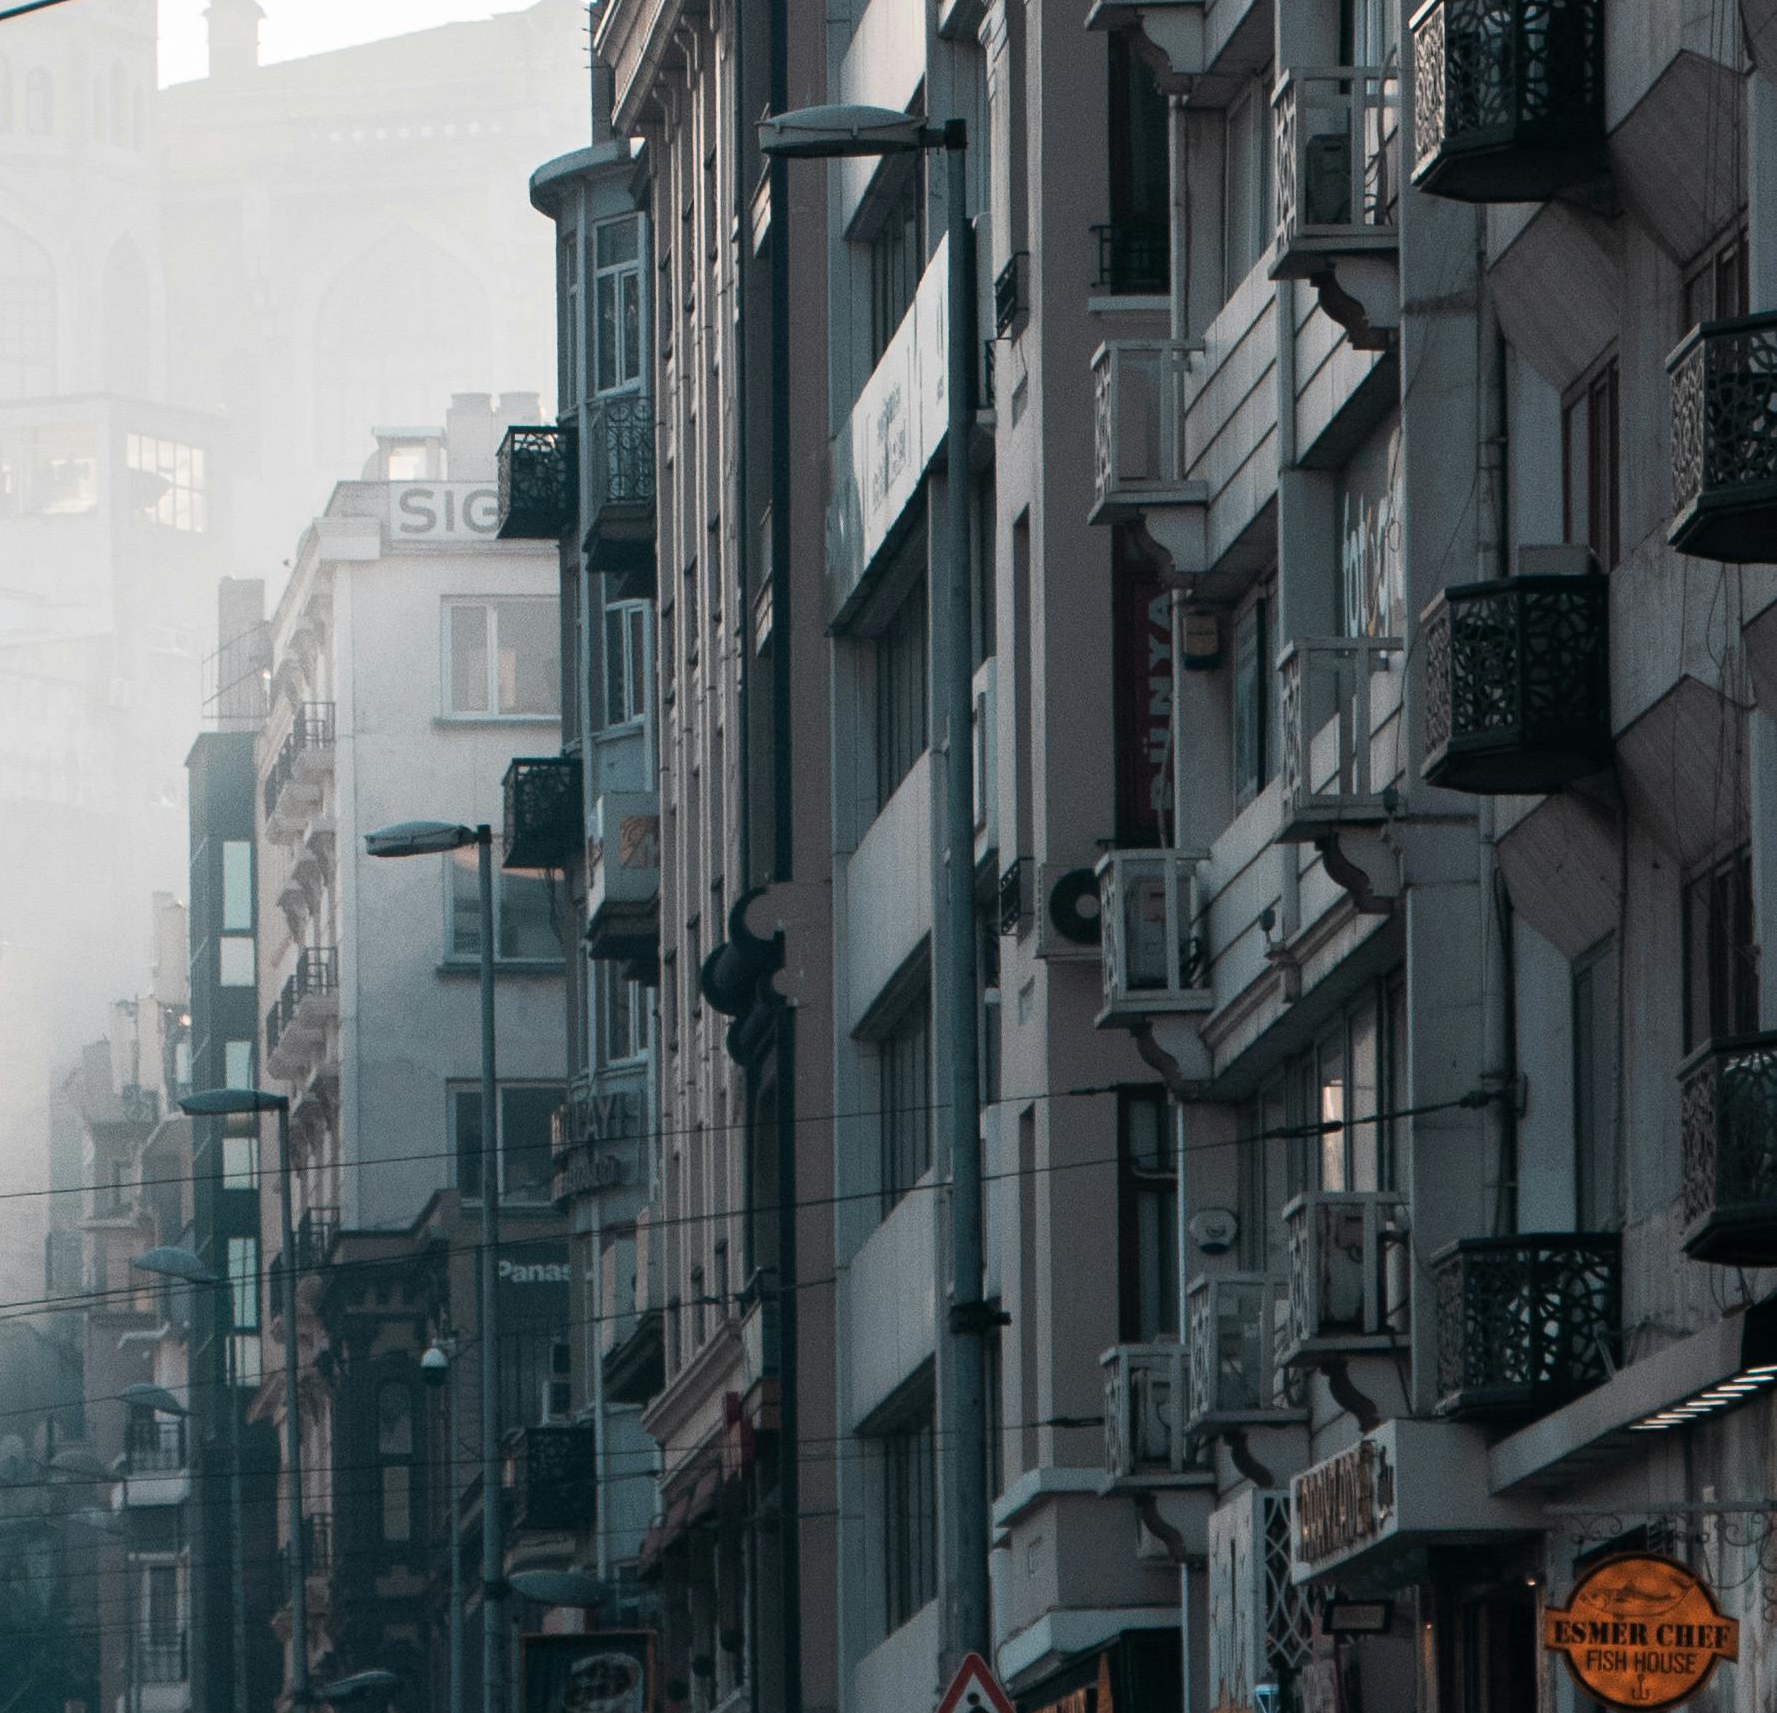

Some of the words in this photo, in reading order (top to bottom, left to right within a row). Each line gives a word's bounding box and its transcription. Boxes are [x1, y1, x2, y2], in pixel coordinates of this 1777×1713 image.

[1554, 1619, 1649, 1647] ESMER
[1656, 1622, 1732, 1650] CHEF
[1585, 1649, 1627, 1673] FISH
[1634, 1651, 1697, 1675] HOUSE
